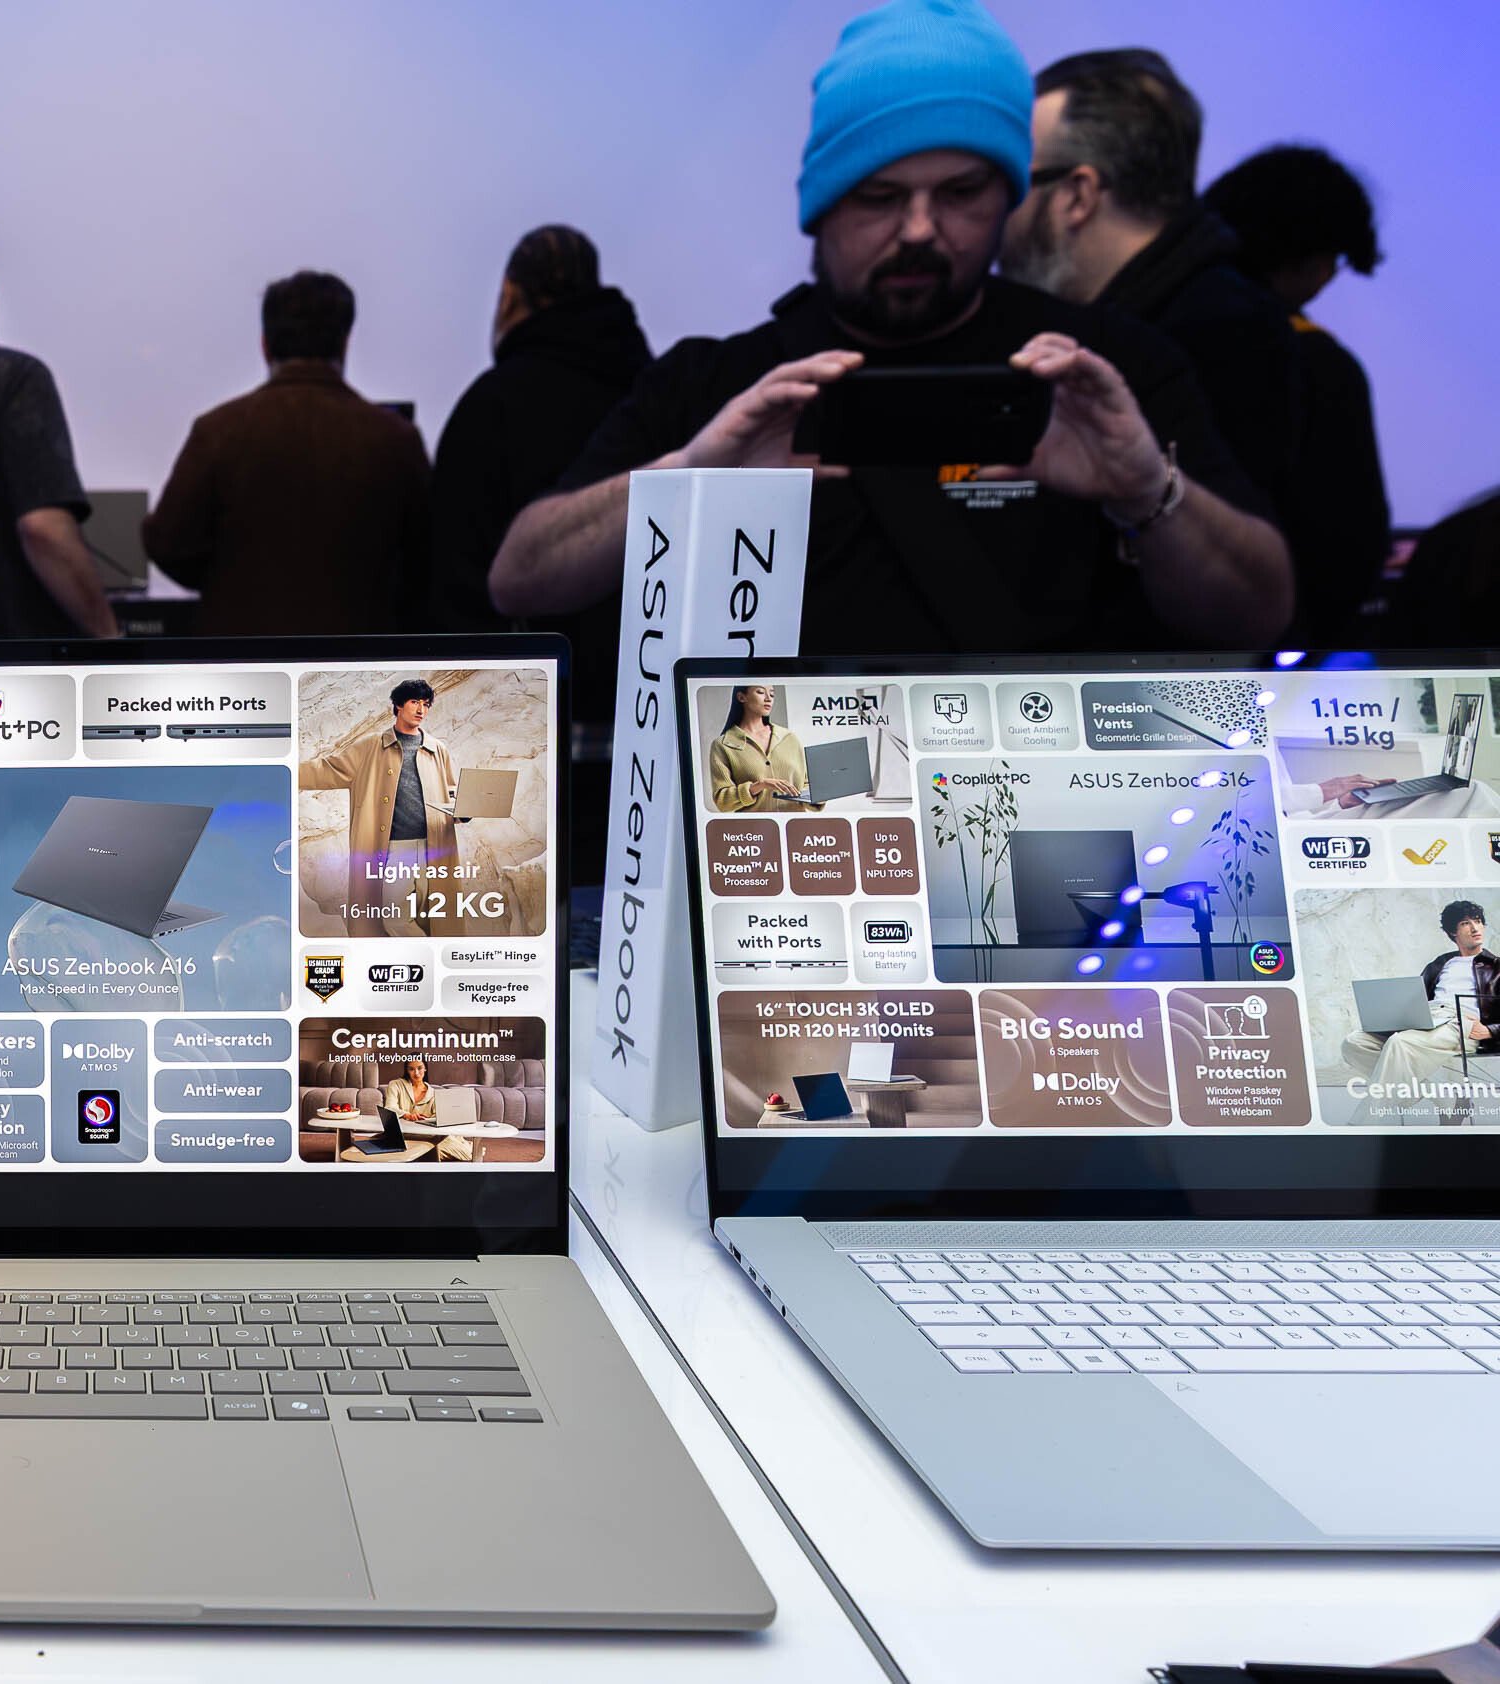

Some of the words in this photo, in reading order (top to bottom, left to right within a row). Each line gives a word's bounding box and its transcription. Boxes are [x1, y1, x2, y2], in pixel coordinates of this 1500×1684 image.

[635, 516, 670, 732] ASUS
[107, 697, 172, 712] Packed
[175, 697, 214, 712] with
[219, 697, 266, 711] Ports
[812, 697, 858, 710] AMD
[1092, 703, 1153, 714] Precision
[1094, 719, 1133, 729] Vents
[1095, 733, 1141, 743] Geometric
[1070, 773, 1123, 788] ASUS
[723, 833, 764, 842] Next-Gen
[804, 836, 836, 846] AMD
[728, 846, 760, 856] AMD
[875, 849, 901, 864] 50
[764, 863, 778, 872] AI
[1309, 861, 1367, 869] CERTIFIED
[365, 862, 422, 884] Light
[425, 864, 448, 878] as
[454, 862, 481, 878] air
[803, 870, 842, 880] Graphics
[866, 869, 887, 878] NPU
[888, 869, 913, 878] TOPS
[724, 878, 769, 886] Processor
[340, 903, 401, 919] 16-inch
[406, 893, 447, 918] 1.2
[456, 892, 505, 918] KG
[611, 751, 654, 1067] Zenbook
[871, 926, 903, 938] 83Wh
[504, 951, 536, 962] Hinge
[2, 958, 60, 975] ASUS
[64, 957, 155, 975] Zenbook
[160, 956, 196, 975] A16
[19, 984, 45, 995] Max
[47, 983, 85, 997] Speed
[88, 983, 99, 994] in
[102, 983, 136, 997] Every
[139, 983, 179, 994] Ounce
[458, 982, 529, 994] Smudge-free
[471, 993, 516, 1004] Keycaps
[786, 1002, 852, 1017] TOUCH
[857, 1002, 880, 1016] 3K
[883, 1002, 934, 1016] OLED
[761, 1024, 801, 1038] HDR
[804, 1024, 835, 1038] 120
[837, 1024, 860, 1038] Hz
[863, 1023, 934, 1037] 1100nits
[1000, 1018, 1052, 1040] BIG
[1058, 1017, 1144, 1040] Sound
[174, 1033, 273, 1047] Anti-scratch
[86, 1043, 135, 1063] Dolby
[329, 1053, 361, 1064] Laptop
[379, 1053, 422, 1064] keyboard
[425, 1053, 454, 1063] frame,
[457, 1053, 491, 1062] bottom
[493, 1053, 515, 1062] case
[1208, 1046, 1270, 1063] Privacy
[81, 1064, 118, 1072] ATMOS
[1195, 1065, 1287, 1080] Protection
[1062, 1072, 1120, 1095] Dolby
[183, 1084, 262, 1097] Anti-wear
[1057, 1096, 1102, 1105] ATMOS
[171, 1133, 275, 1151] Smudge-free
